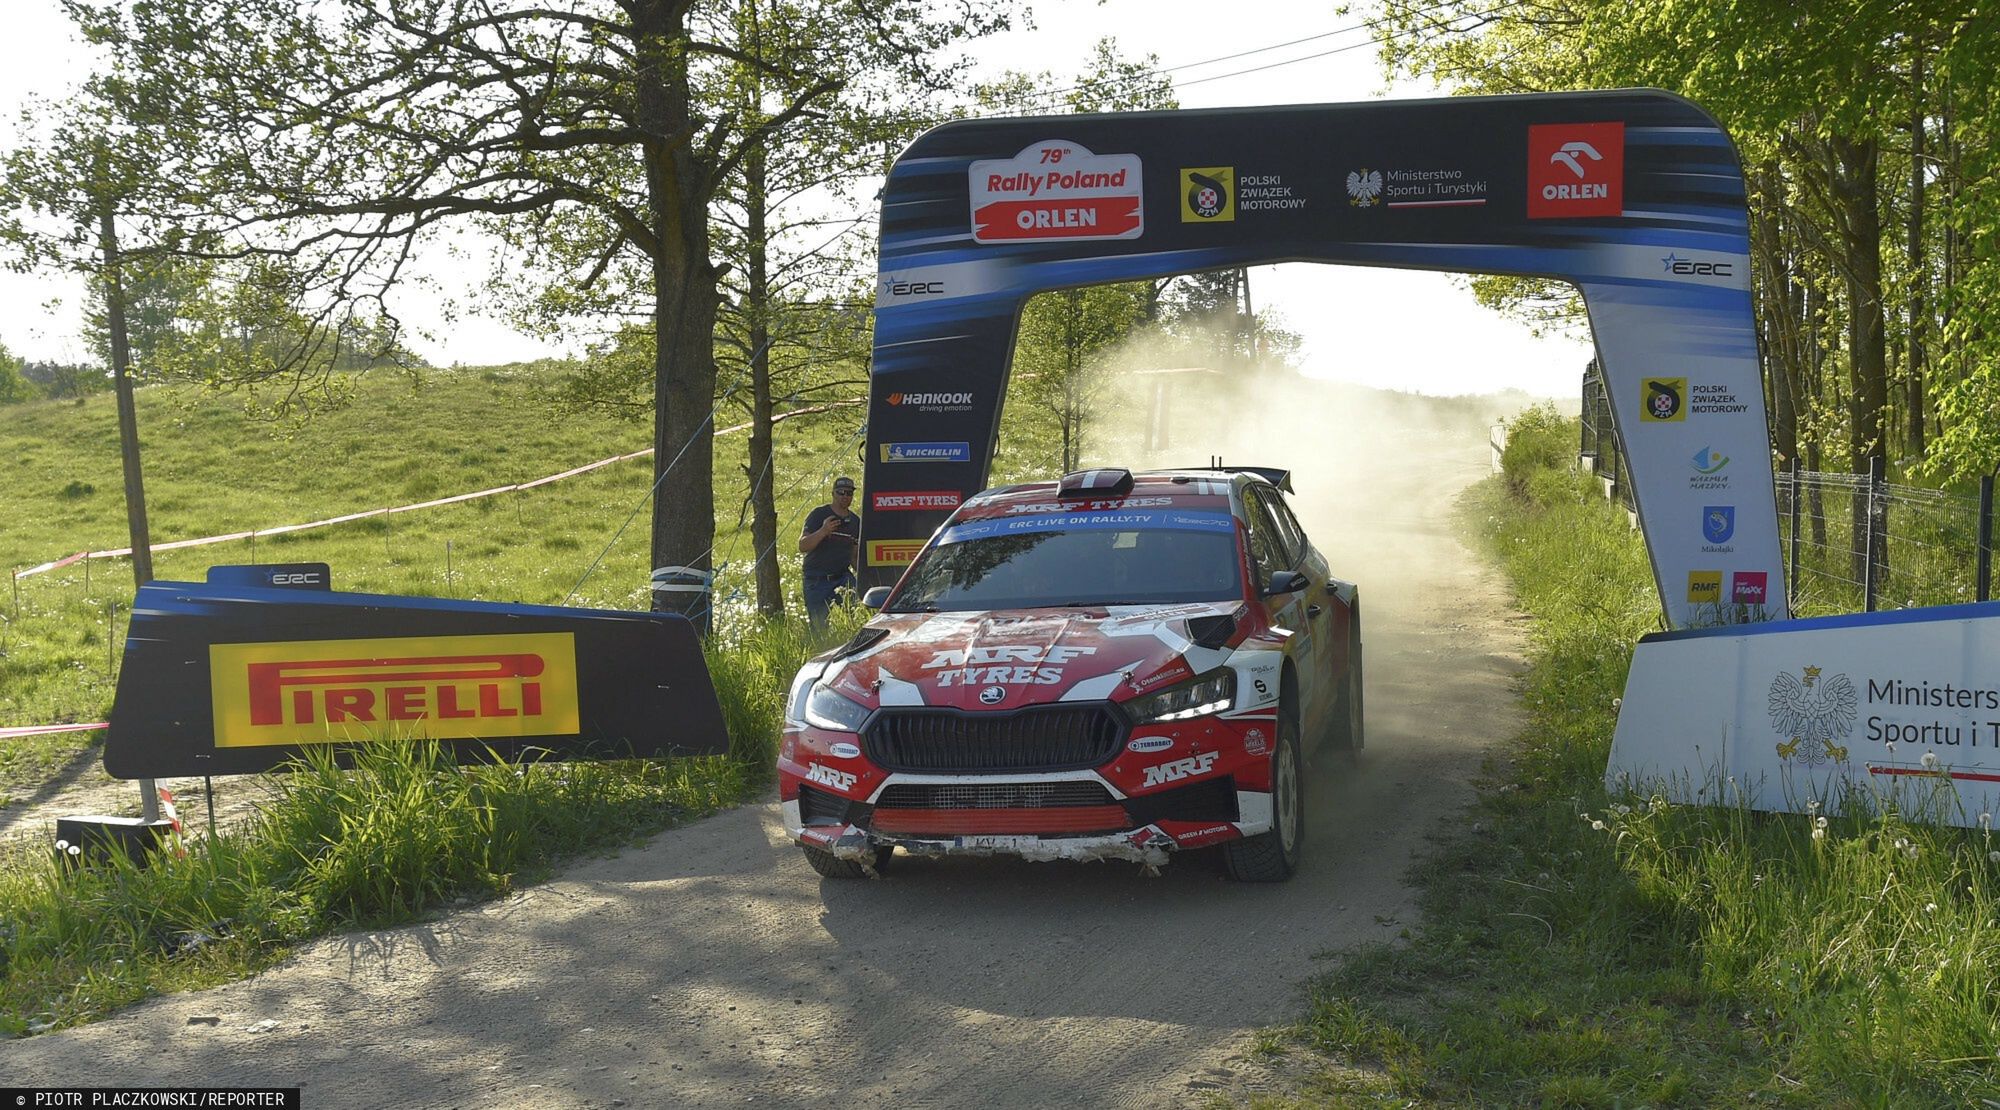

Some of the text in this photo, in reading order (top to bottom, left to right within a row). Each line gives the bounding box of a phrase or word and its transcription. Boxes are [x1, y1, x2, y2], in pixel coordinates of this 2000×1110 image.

[1040, 148, 1071, 164] 79th
[1241, 175, 1281, 186] POLSKI
[1387, 169, 1462, 181] Ministerstwo
[987, 169, 1126, 196] Rally Poland
[1387, 181, 1487, 197] Sportu i Turystyki
[1241, 187, 1292, 199] ZWIĄZEK
[1542, 184, 1608, 200] ORLEN
[1241, 199, 1306, 210] MOTOROWY
[1017, 208, 1096, 229] ORLEN
[1197, 207, 1219, 217] PZM
[1672, 261, 1733, 277] ERC
[892, 281, 944, 296] ERC
[1693, 385, 1727, 393] POLSKI
[1693, 395, 1736, 404] ZWIĄZEK
[919, 404, 943, 412] driving
[1654, 410, 1672, 418] PZM
[1692, 404, 1748, 413] MOTOROWY
[906, 448, 961, 457] MICHELIN
[876, 496, 915, 507] MRF
[916, 495, 958, 506] TYRES
[1005, 497, 1173, 513] MRF TYRES
[1009, 520, 1034, 529] ERC
[1036, 518, 1065, 526] LIVE
[1069, 516, 1088, 524] ON
[1091, 515, 1152, 524] RALLY.TV
[876, 544, 922, 561] PIRE
[273, 572, 320, 585] ERC
[1691, 583, 1719, 592] RMF
[921, 645, 1097, 669] MRF
[936, 666, 1063, 687] TYRES
[247, 653, 545, 726] PIRELLI
[1867, 716, 1960, 748] Sportu
[1971, 720, 1977, 747] i
[1142, 750, 1219, 788] MRF
[805, 762, 857, 791] MRF
